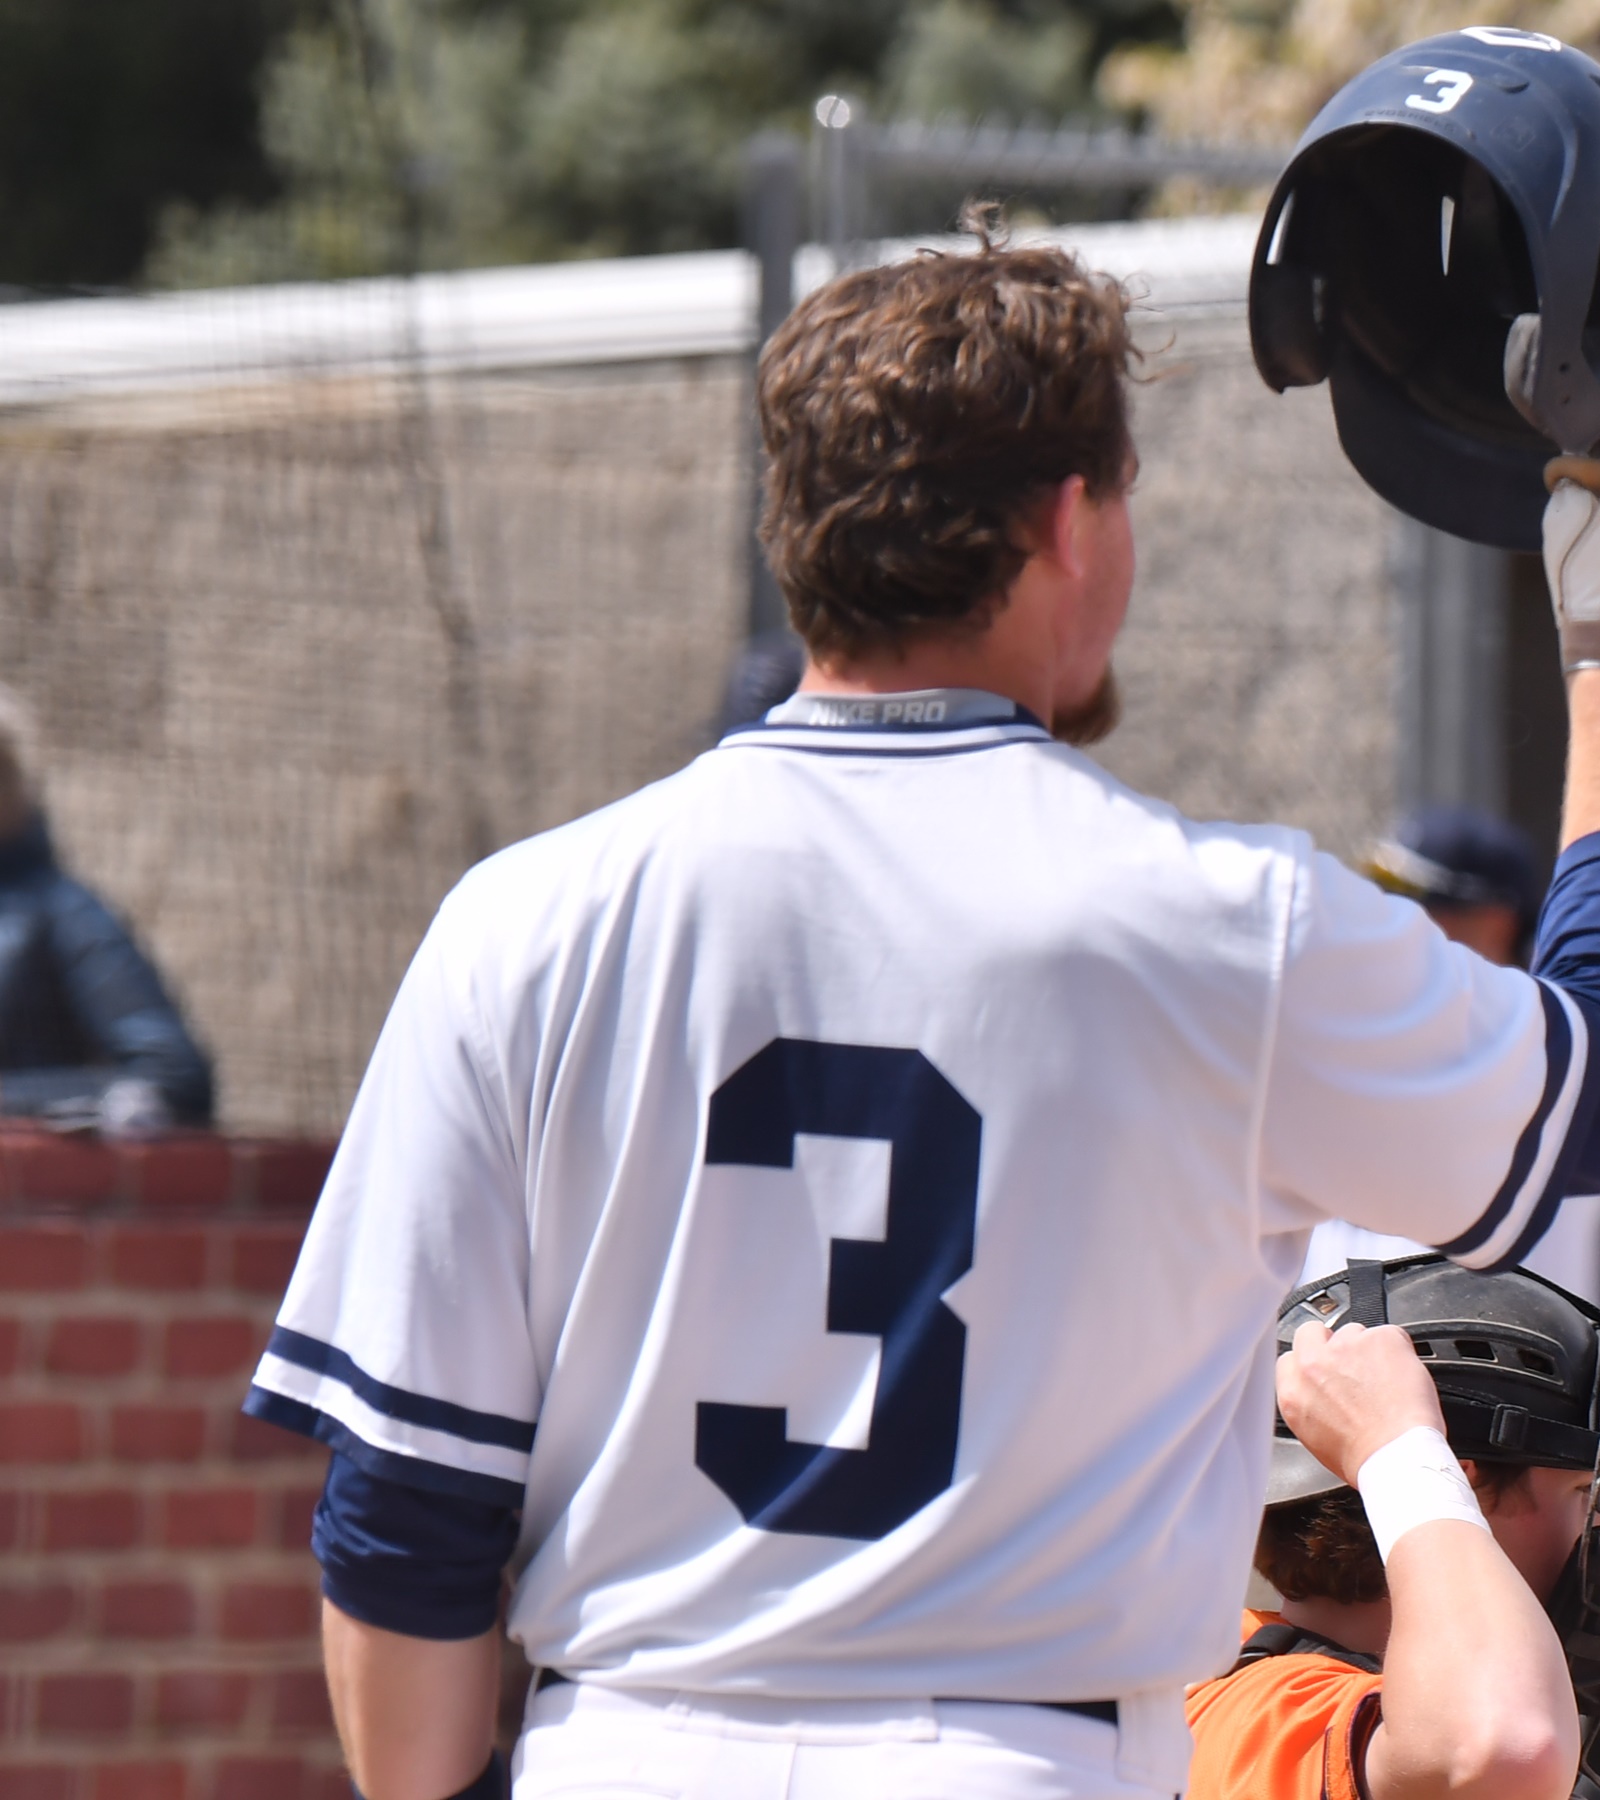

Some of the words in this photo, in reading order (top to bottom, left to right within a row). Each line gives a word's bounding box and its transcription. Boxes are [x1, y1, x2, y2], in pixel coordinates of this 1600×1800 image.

[1405, 69, 1474, 114] 3
[808, 702, 877, 727] NIKE
[881, 701, 947, 725] PRO
[694, 1037, 983, 1542] 3
